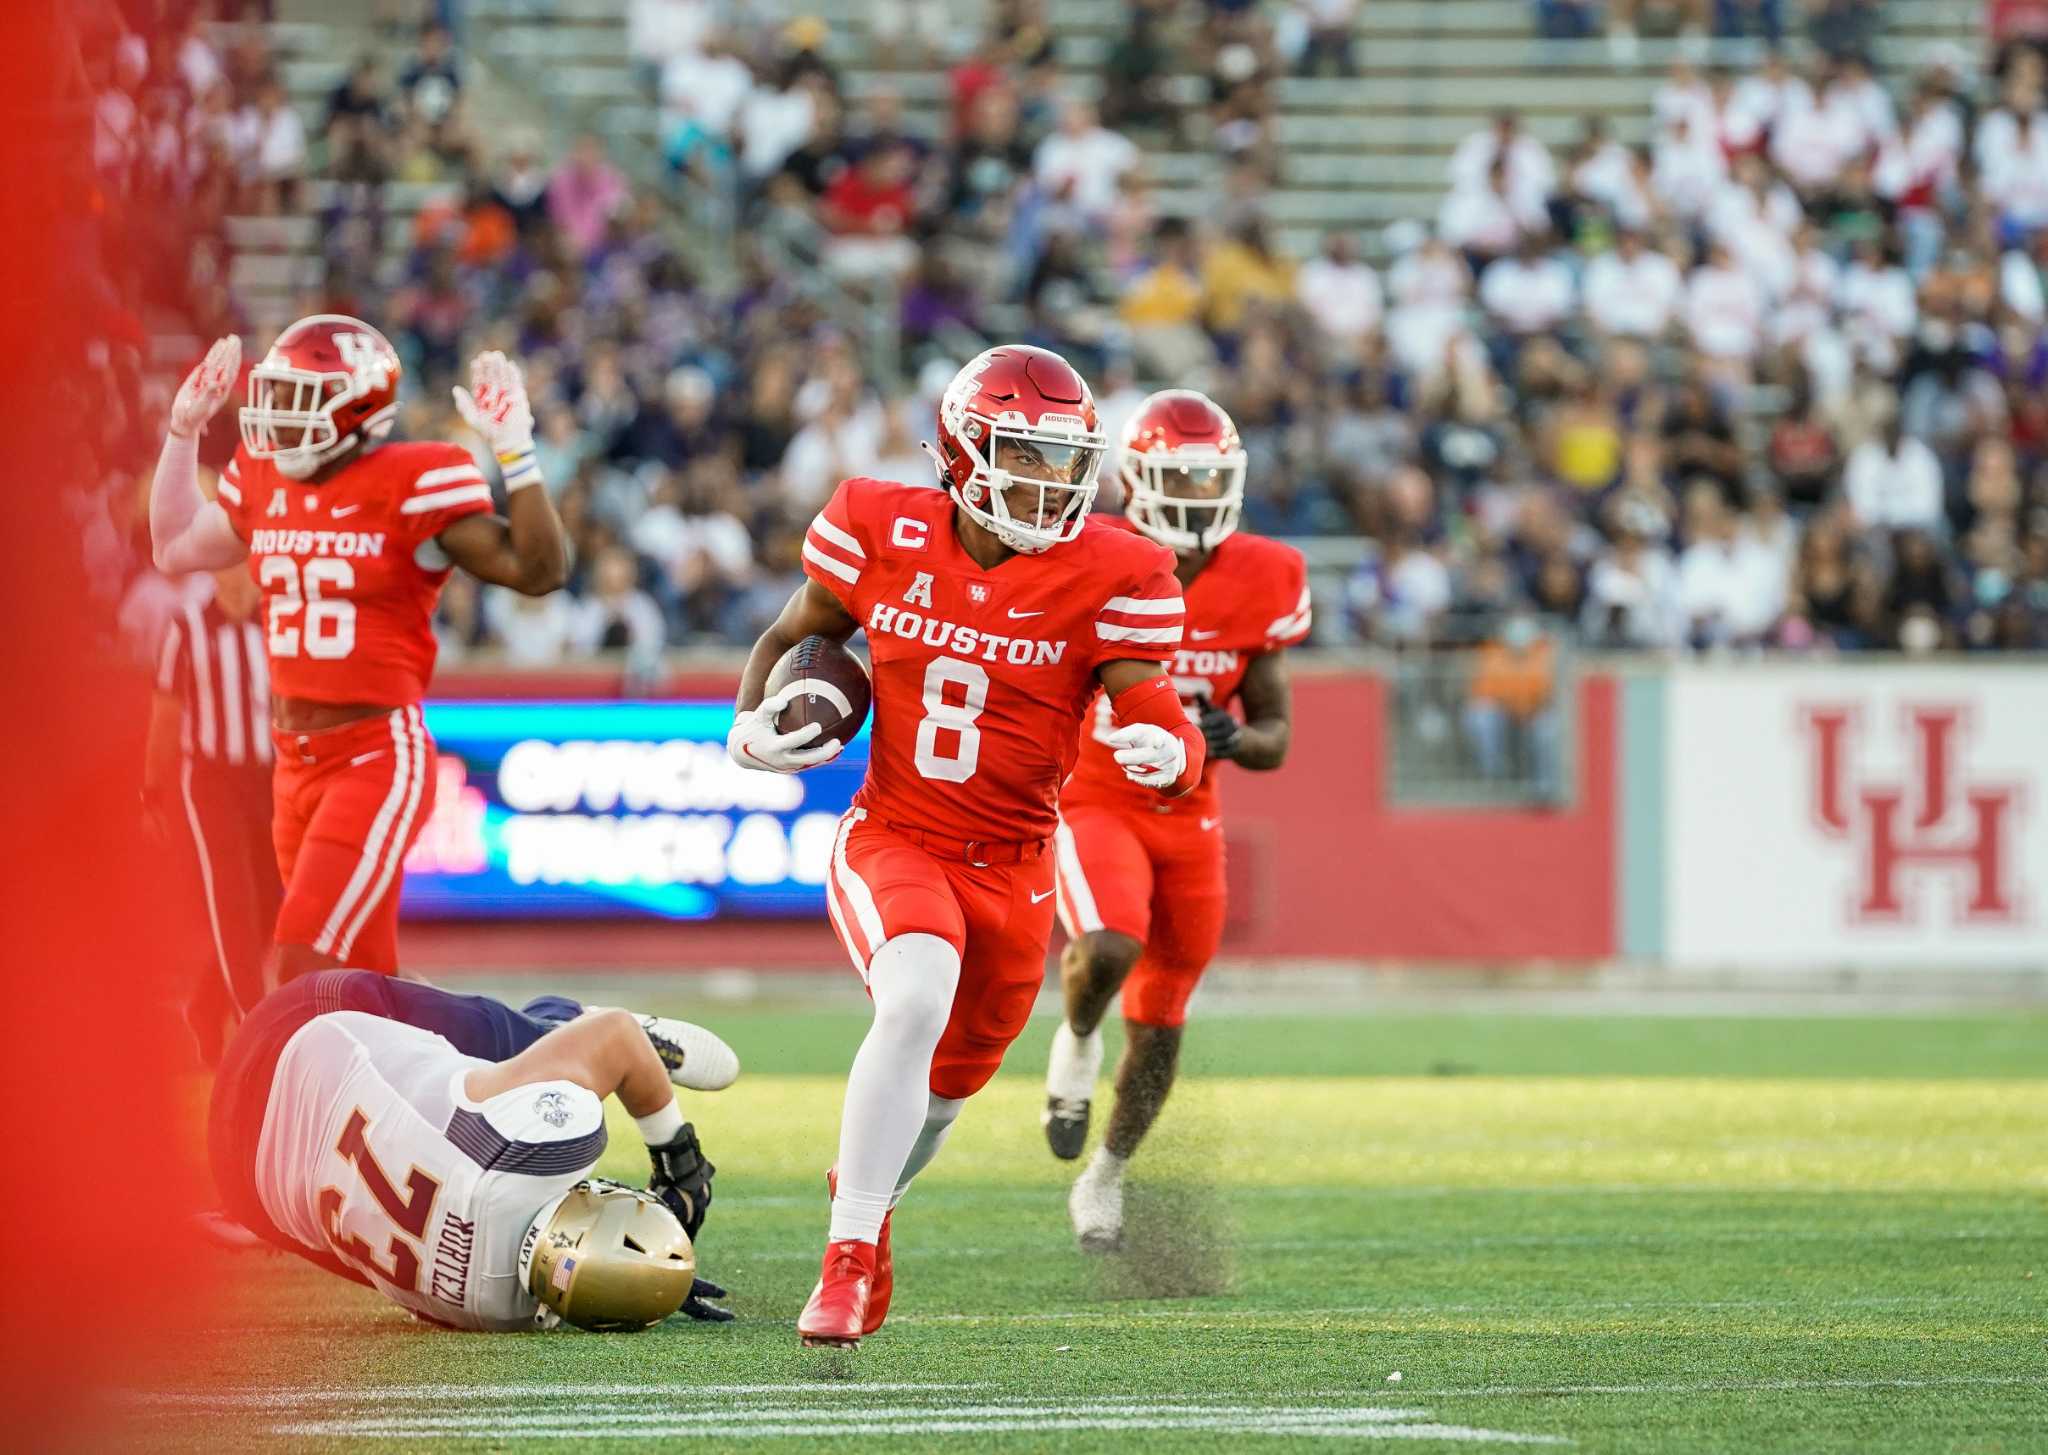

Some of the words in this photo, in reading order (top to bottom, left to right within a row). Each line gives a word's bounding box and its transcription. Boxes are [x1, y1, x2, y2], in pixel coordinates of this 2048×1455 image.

[1044, 415, 1083, 425] HOUSTON
[250, 529, 386, 557] HOUSTON
[892, 516, 928, 548] C
[260, 555, 357, 660] 26
[903, 571, 934, 608] A
[869, 602, 1067, 666] HOUSTON
[914, 655, 990, 784] 8
[1800, 705, 2018, 923] UH
[318, 1104, 443, 1292] 73
[520, 1225, 540, 1269] NAVY
